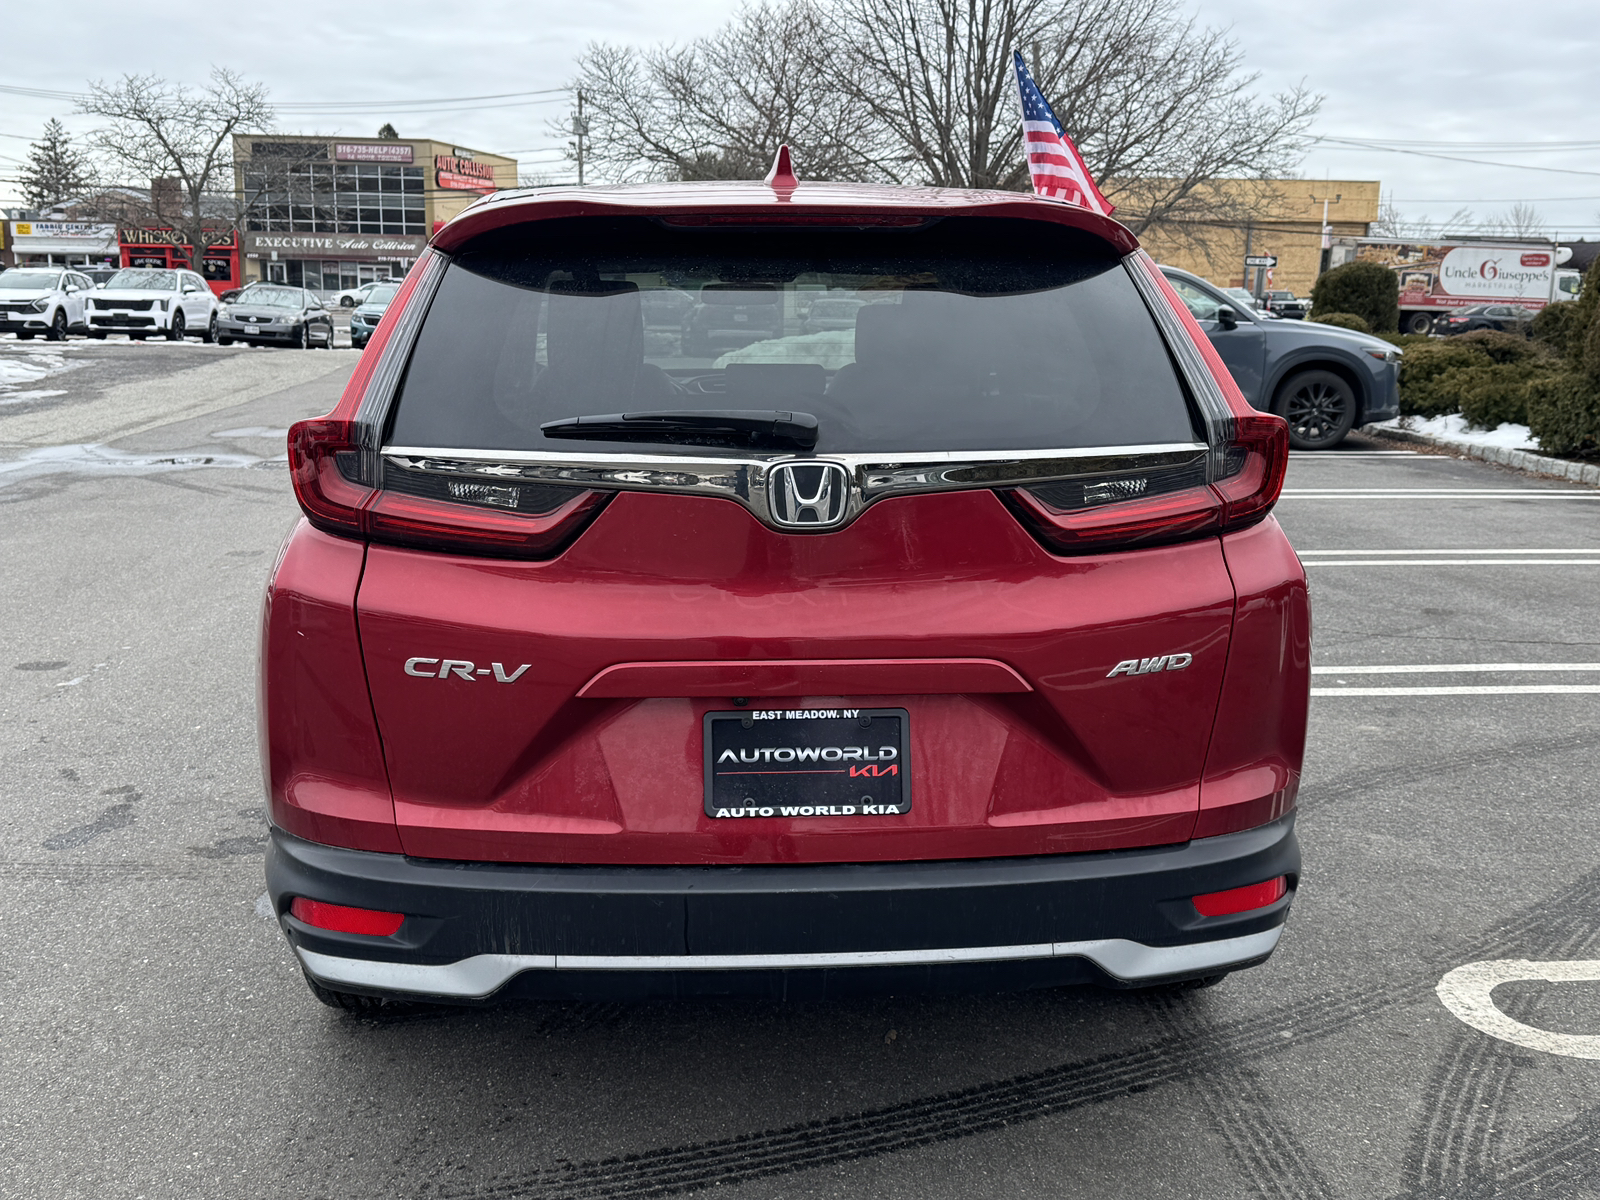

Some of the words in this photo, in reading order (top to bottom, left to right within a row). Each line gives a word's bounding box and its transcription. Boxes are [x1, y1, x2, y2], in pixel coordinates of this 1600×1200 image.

[437, 155, 456, 172] AUTO
[459, 159, 494, 179] COLLISION
[123, 230, 188, 244] WHISKEY
[255, 237, 334, 249] EXECUTIVE
[336, 239, 369, 250] Auto
[372, 240, 416, 250] Collision
[1445, 266, 1478, 279] Uncle
[1480, 258, 1549, 283] Giuseppe's
[403, 656, 532, 683] CR-V
[1105, 652, 1193, 678] AWD
[752, 711, 782, 720] EAST
[843, 709, 860, 719] NY
[716, 745, 898, 764] AUTOWORLD
[849, 764, 898, 777] KIA
[716, 807, 774, 818] AUTO
[780, 805, 856, 816] WORLD
[862, 804, 900, 815] KIA
